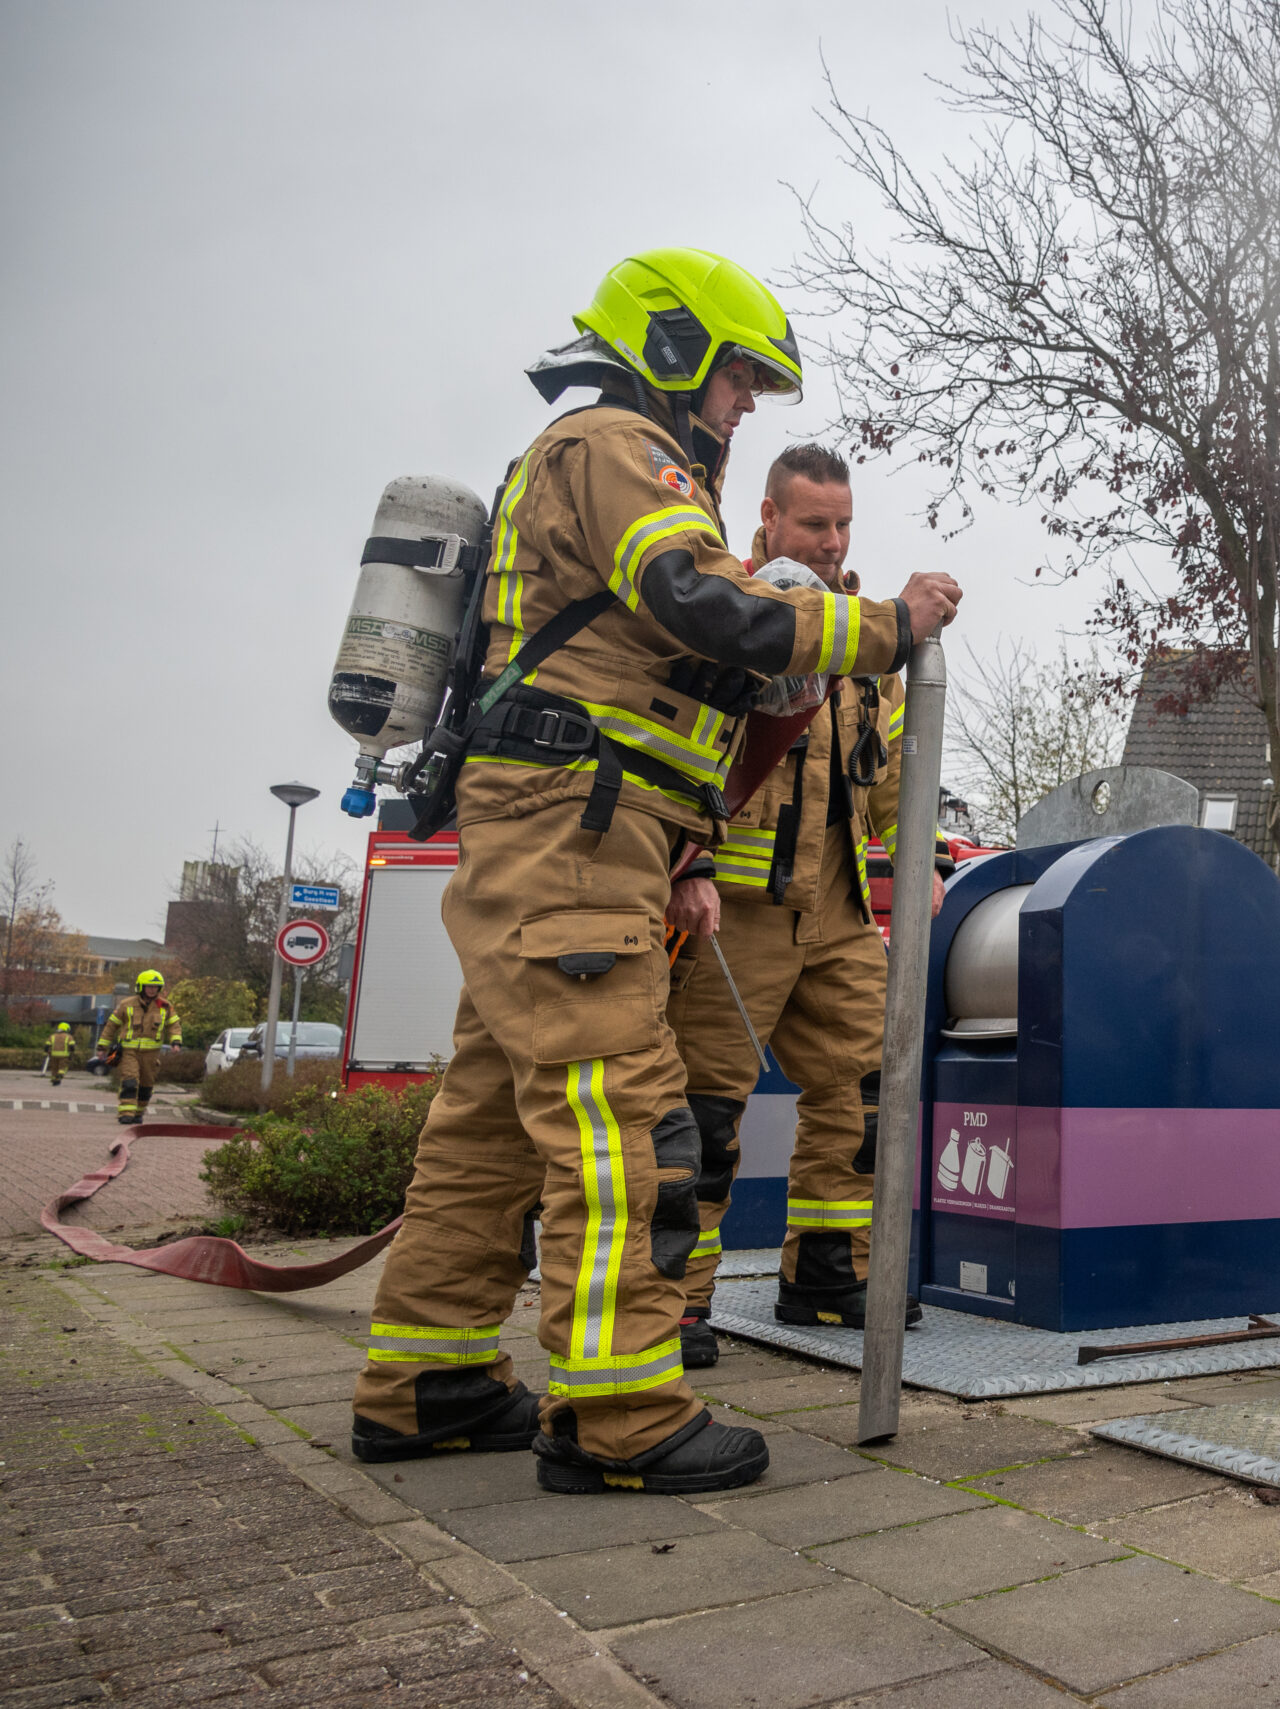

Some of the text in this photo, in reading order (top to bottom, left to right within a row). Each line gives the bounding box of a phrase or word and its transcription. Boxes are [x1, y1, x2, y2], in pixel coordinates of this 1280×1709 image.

[349, 619, 384, 633] MSA
[414, 634, 448, 655] MSA
[482, 666, 519, 710] MSA
[963, 1111, 988, 1127] PMD
